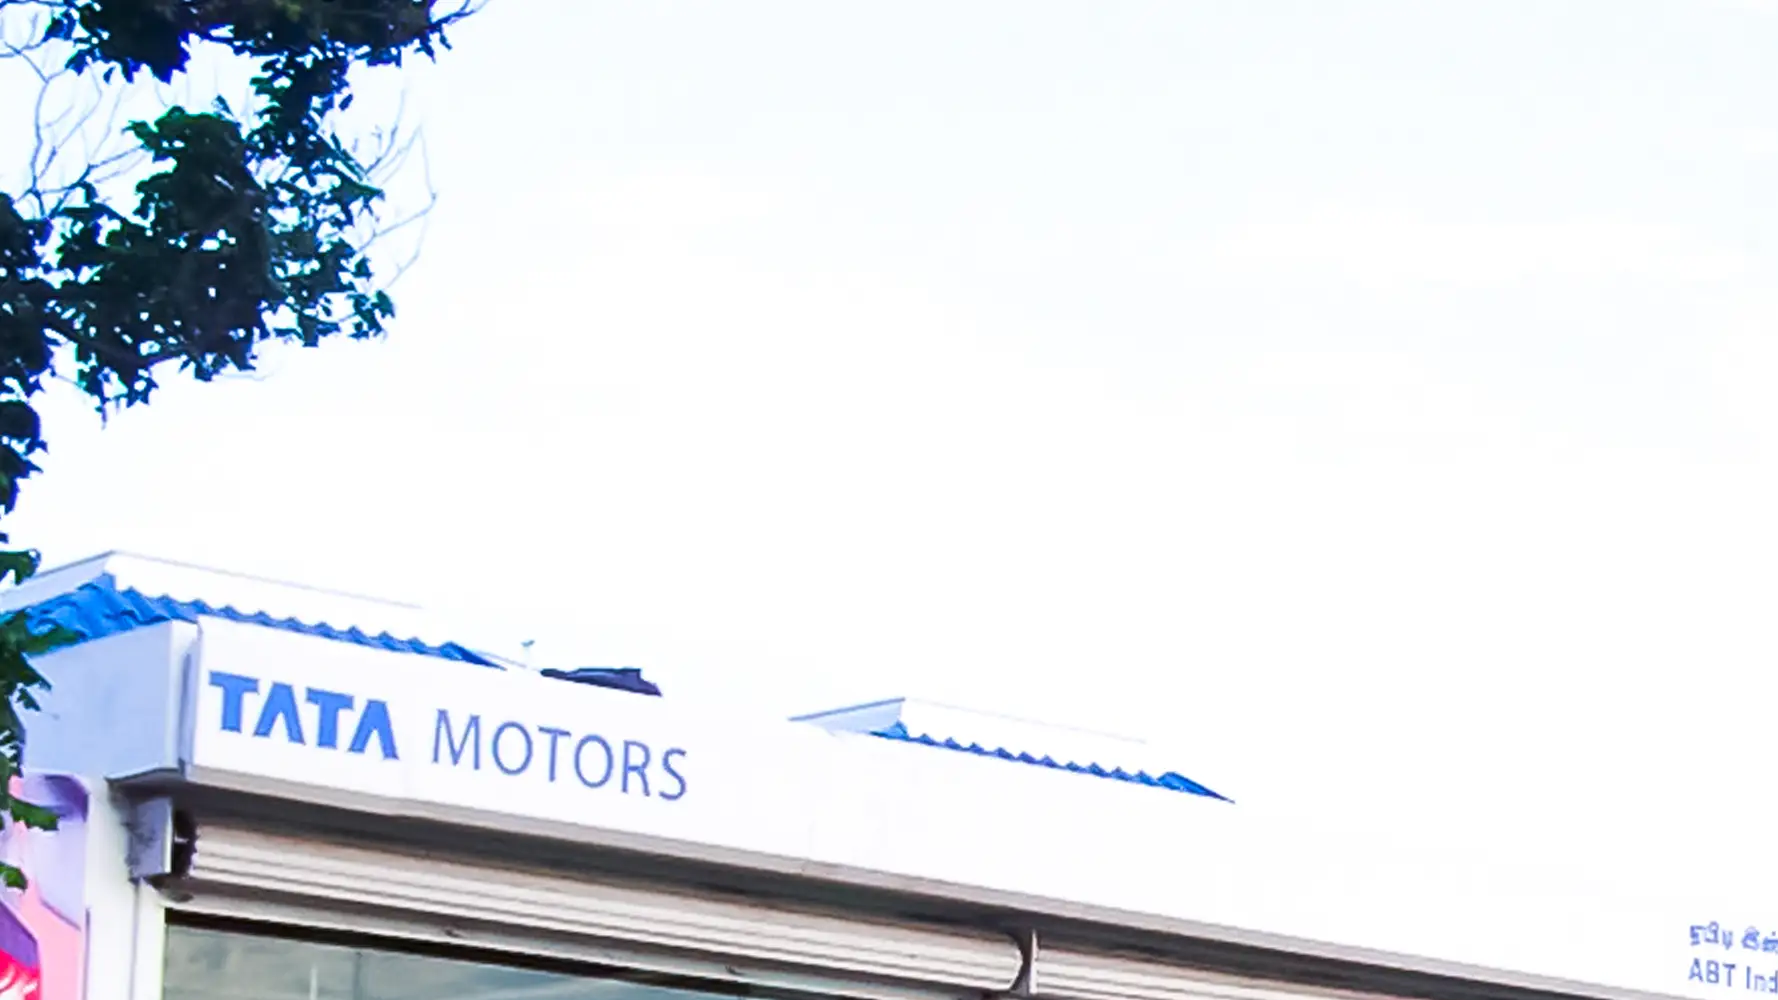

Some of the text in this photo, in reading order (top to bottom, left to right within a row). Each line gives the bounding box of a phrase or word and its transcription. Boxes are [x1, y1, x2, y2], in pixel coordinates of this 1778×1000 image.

[209, 671, 687, 800] TATA MOTORS
[1688, 957, 1736, 987] ABT
